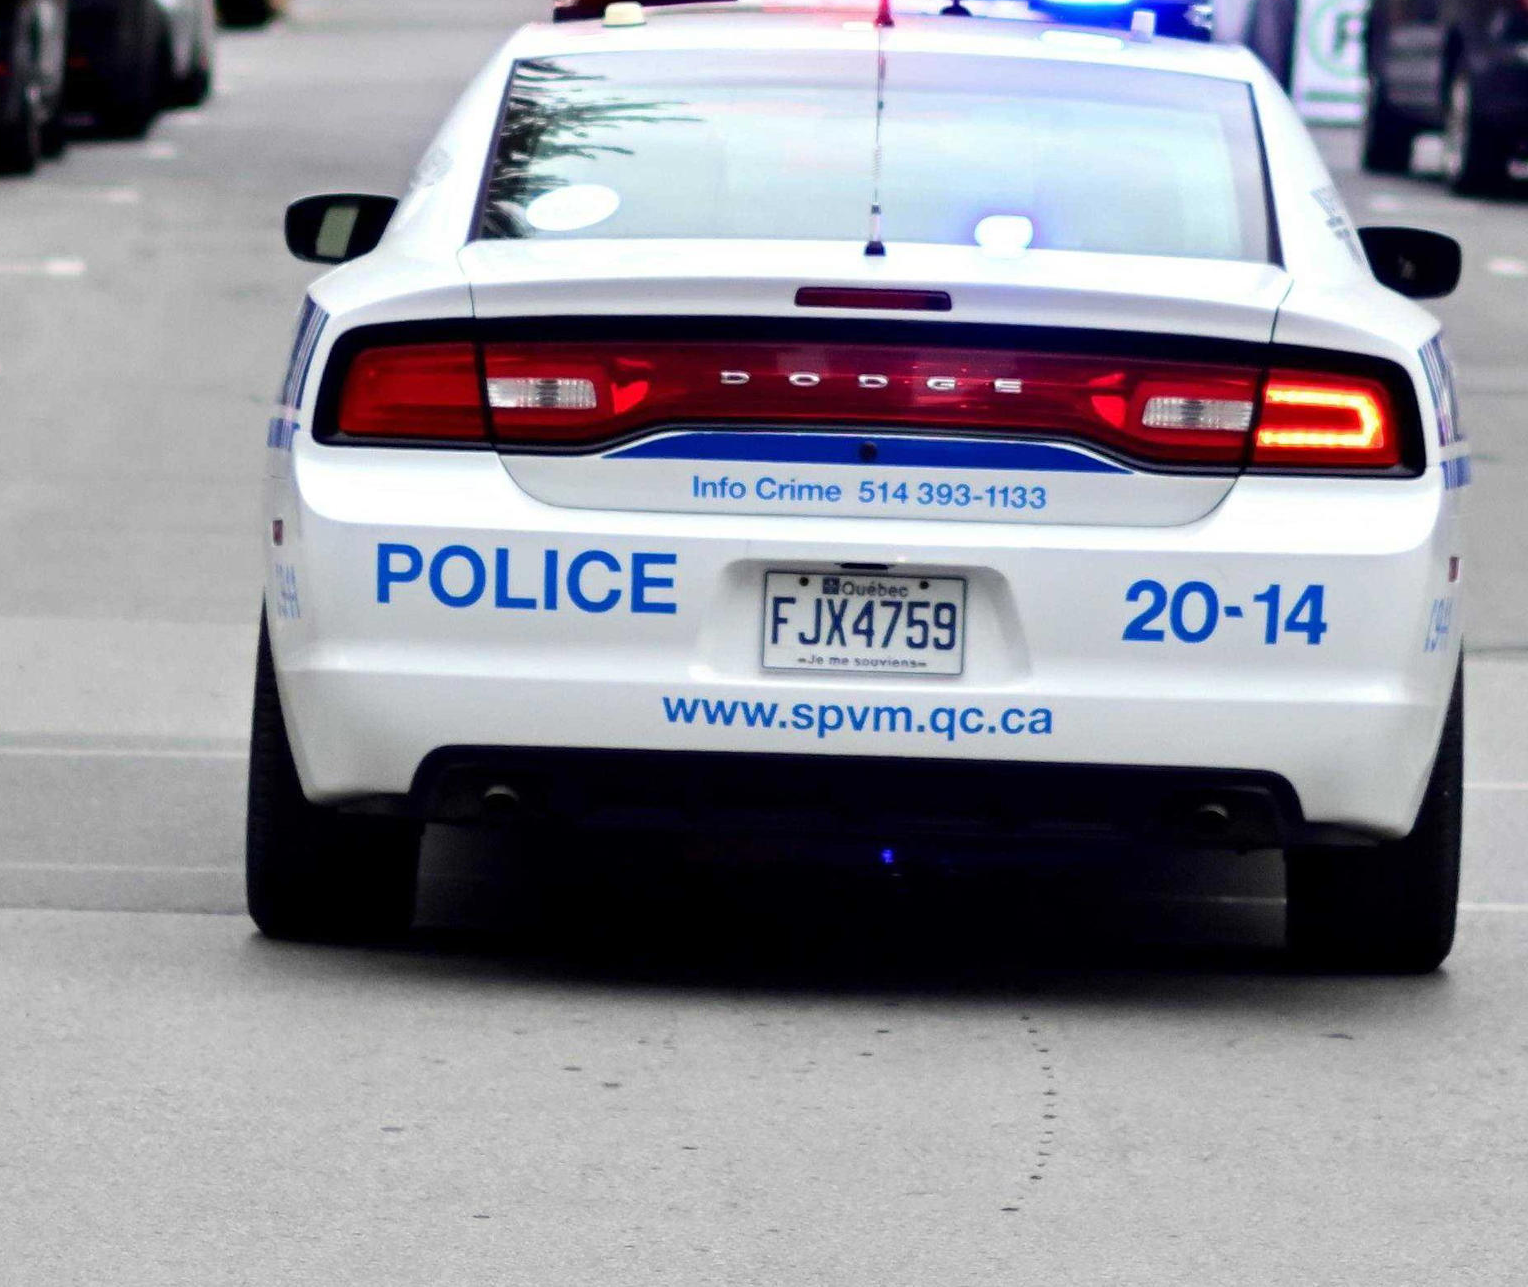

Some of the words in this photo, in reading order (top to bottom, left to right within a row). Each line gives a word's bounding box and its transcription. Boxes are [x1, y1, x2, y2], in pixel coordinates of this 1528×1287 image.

[719, 369, 1023, 394] DODGE
[691, 474, 748, 501] Info
[754, 476, 843, 503] Crime
[858, 480, 910, 505] 514
[917, 483, 1048, 510] 393-1133
[376, 542, 678, 615] POLICE
[770, 596, 957, 651] FJX4759
[1121, 578, 1329, 646] 20-14
[829, 656, 849, 666] me
[662, 695, 1054, 742] www.spvm.qc.ca
